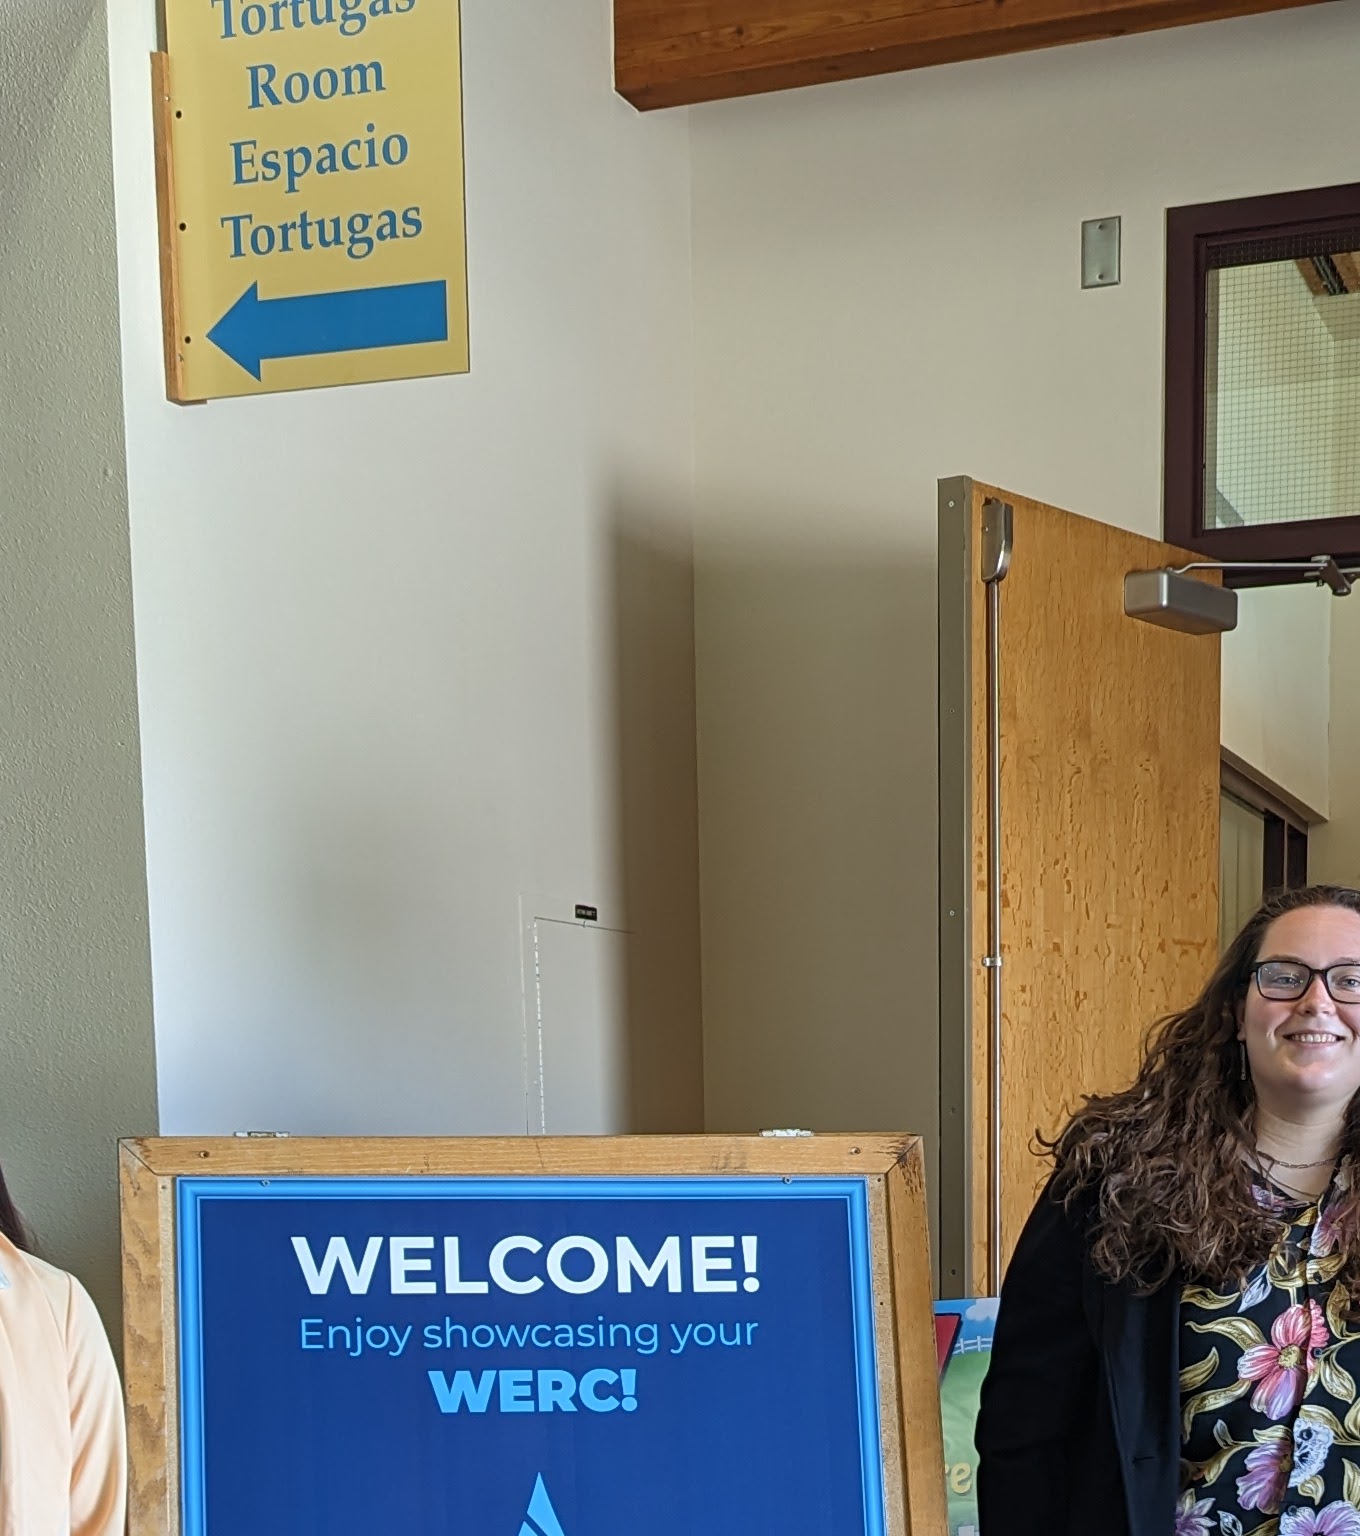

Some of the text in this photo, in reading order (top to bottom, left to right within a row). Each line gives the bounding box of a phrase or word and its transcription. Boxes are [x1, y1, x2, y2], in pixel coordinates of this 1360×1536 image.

[246, 59, 386, 110] Room
[229, 123, 409, 194] Espacio
[220, 206, 423, 260] Tortugas
[291, 1235, 761, 1295] WELCOME!
[300, 1315, 759, 1356] Enjoy showcasing your
[428, 1368, 638, 1413] WERC!
